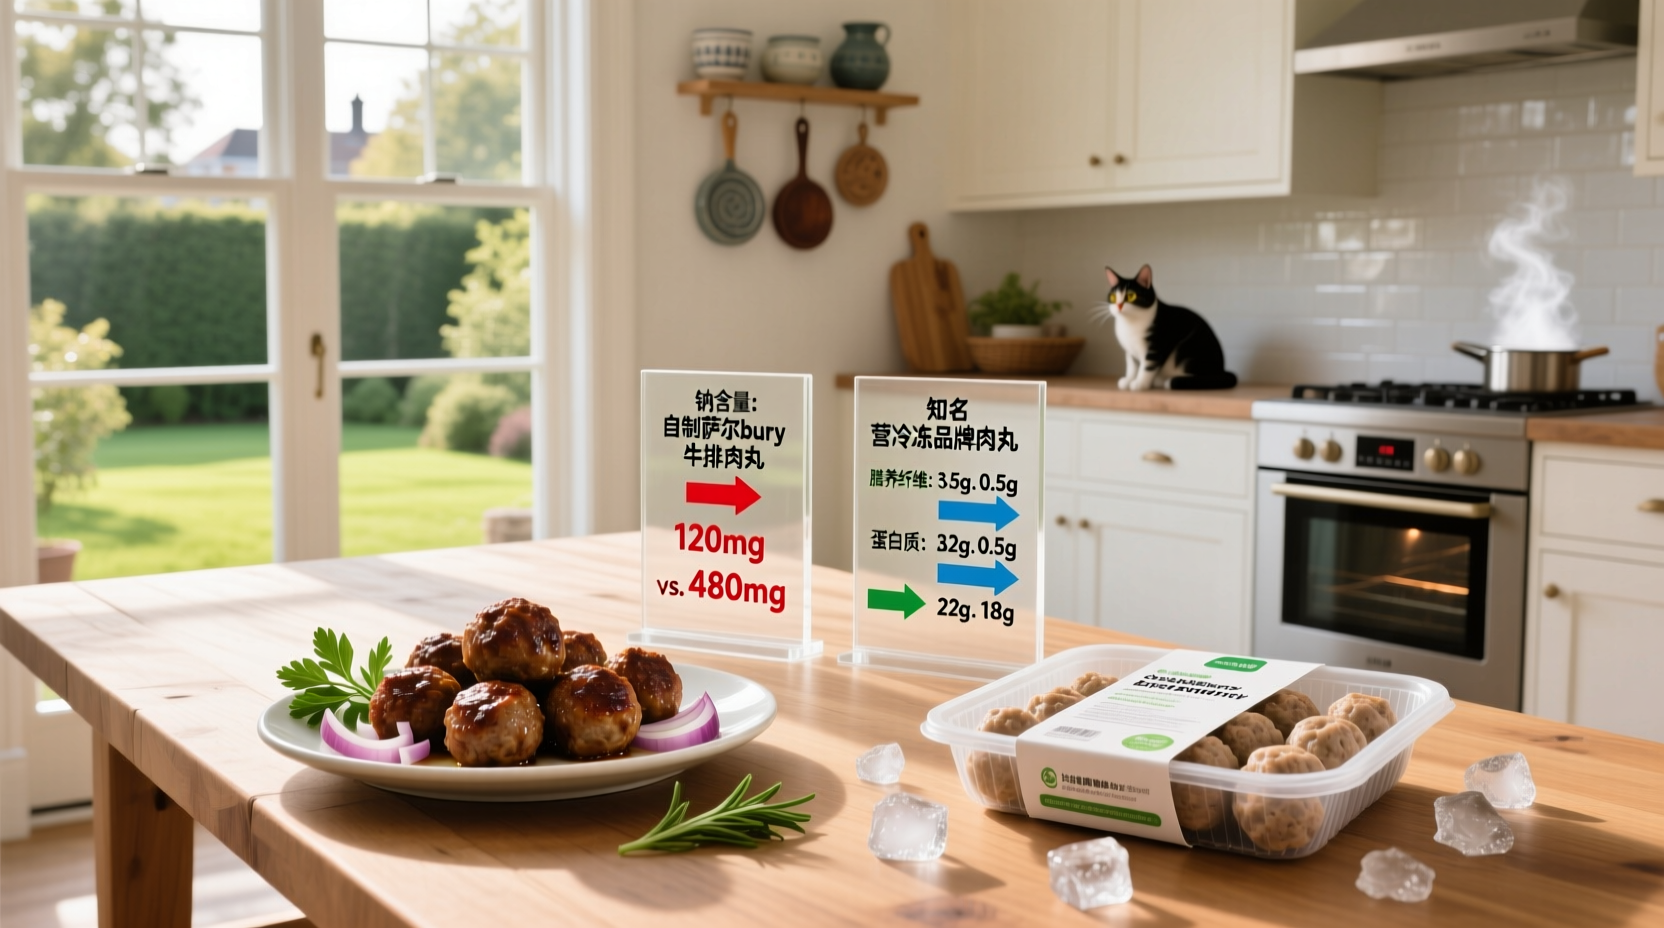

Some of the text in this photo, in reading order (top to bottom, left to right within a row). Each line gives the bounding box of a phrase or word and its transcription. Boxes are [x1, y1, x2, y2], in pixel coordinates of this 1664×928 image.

[695, 389, 757, 412] 钠含量:
[927, 397, 968, 421] 知名
[664, 414, 785, 446] 自制萨尔bury
[871, 423, 1018, 452] 营冷冻品牌肉丸
[684, 443, 764, 469] 牛排肉丸
[979, 473, 1018, 497] 0.5g
[675, 523, 764, 564] 120mg
[871, 530, 1016, 561] 蛋白质: 32g. 0.5g
[657, 570, 785, 613] vs. 480mg
[937, 598, 1014, 626] 22g. 18g
